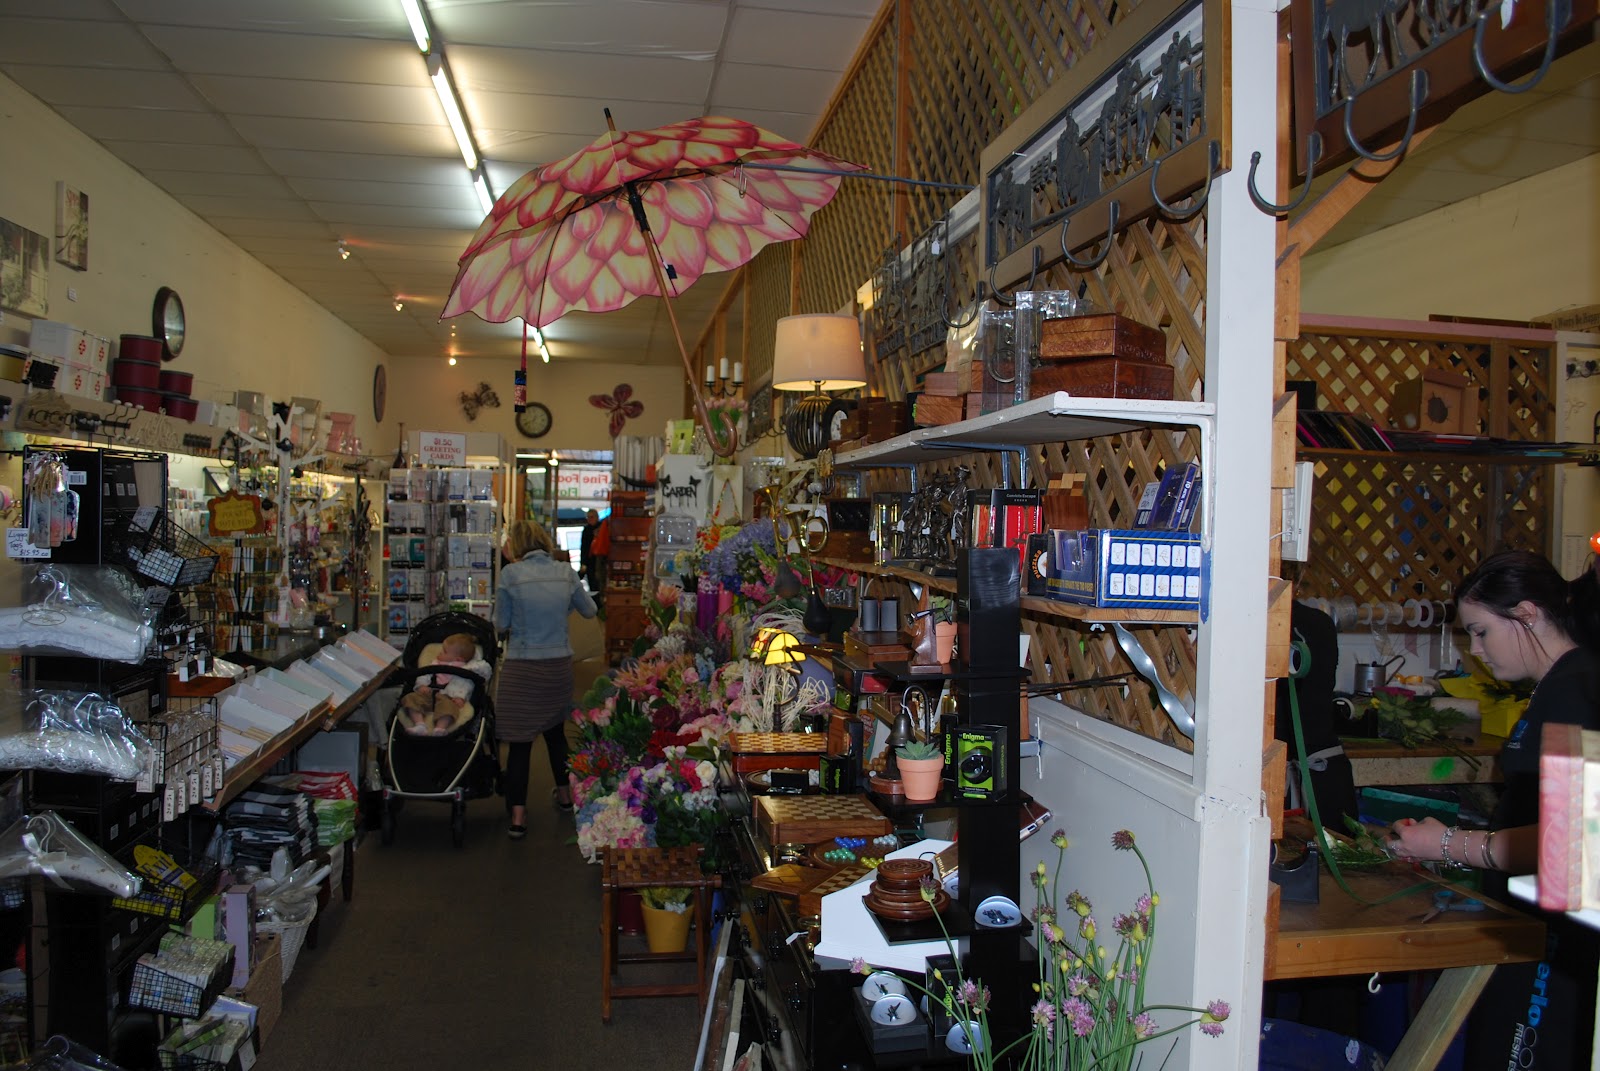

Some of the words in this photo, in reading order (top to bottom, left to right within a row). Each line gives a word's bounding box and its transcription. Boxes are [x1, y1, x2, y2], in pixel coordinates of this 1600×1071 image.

[423, 446, 461, 454] GREETING
[662, 485, 698, 499] GARDEN
[962, 732, 985, 742] Enigma
[944, 733, 953, 765] Enigma
[1510, 1022, 1525, 1060] FRESH
